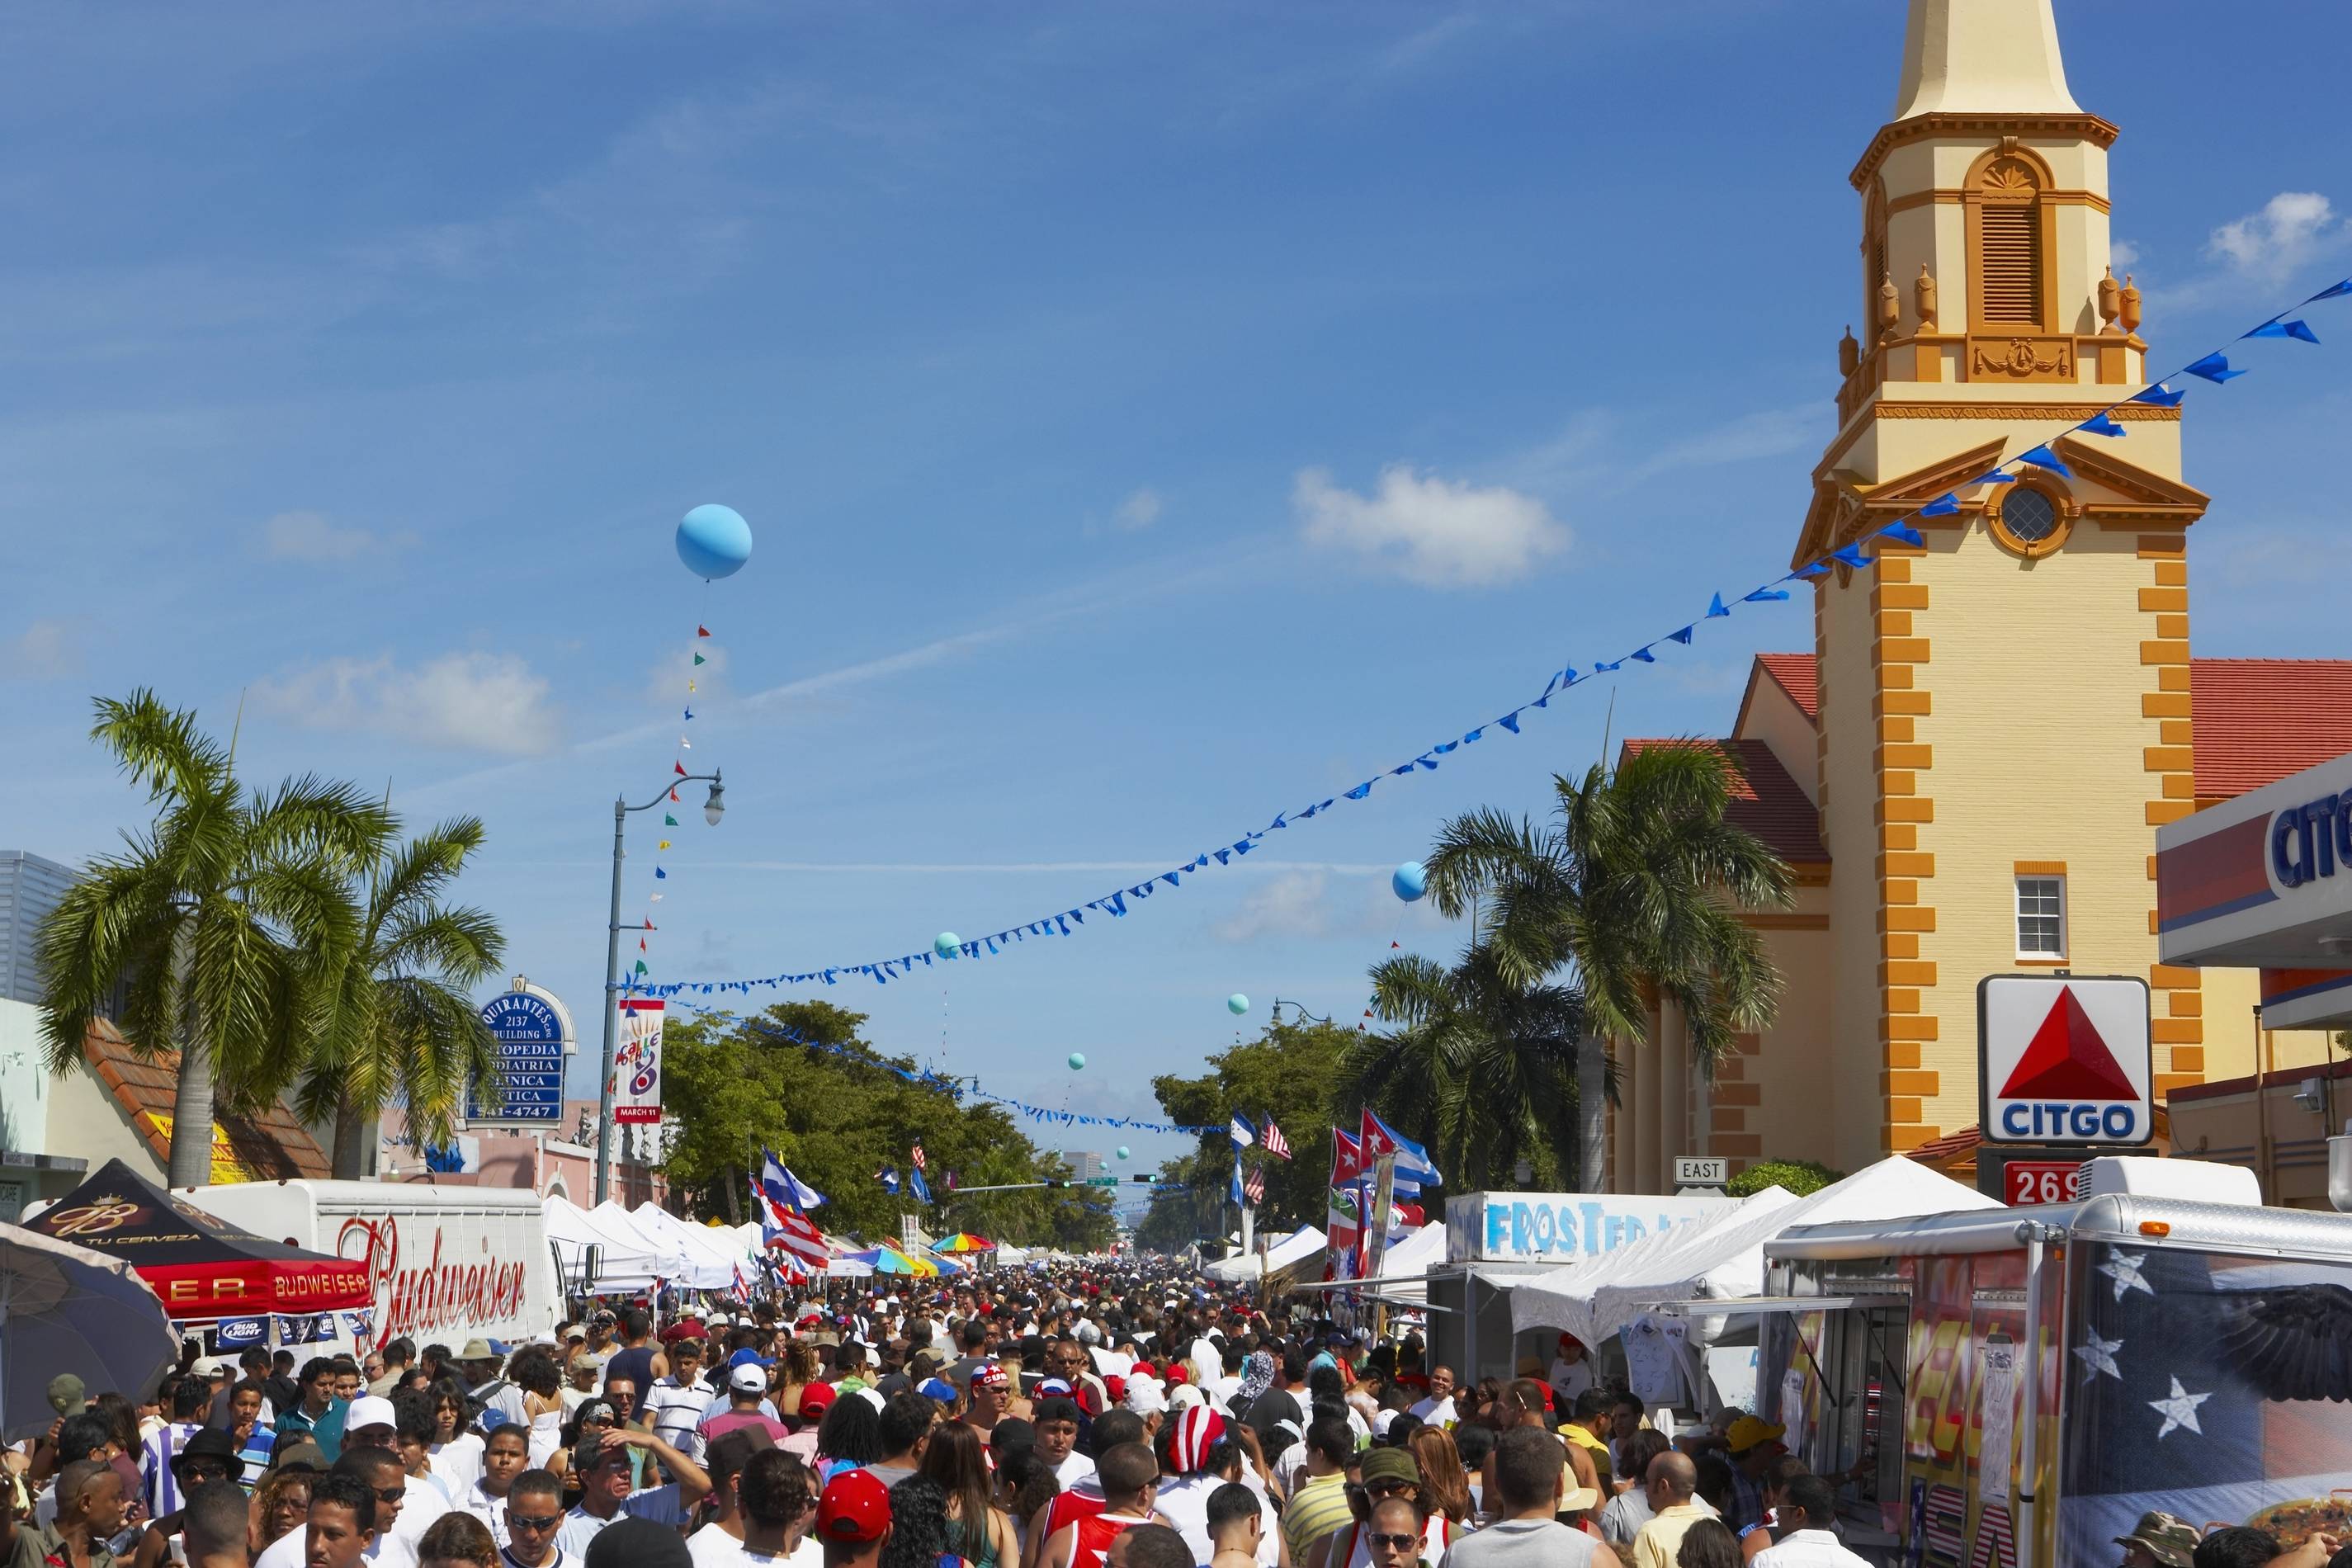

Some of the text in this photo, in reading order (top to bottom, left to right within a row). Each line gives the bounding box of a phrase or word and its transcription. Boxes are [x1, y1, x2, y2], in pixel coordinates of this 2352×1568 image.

[506, 1016, 528, 1027] 2137
[494, 1029, 541, 1040] BUILDING
[620, 1108, 647, 1117] MARCH
[2003, 1103, 2135, 1137] CITGO
[1684, 1163, 1720, 1178] EAST
[2017, 1172, 2080, 1204] 269
[116, 1234, 201, 1244] CERVEZA
[275, 1273, 368, 1298] BUDWEISER
[338, 1215, 525, 1358] Budweiser
[233, 1322, 258, 1330] BUD
[228, 1328, 262, 1337] LIGHT
